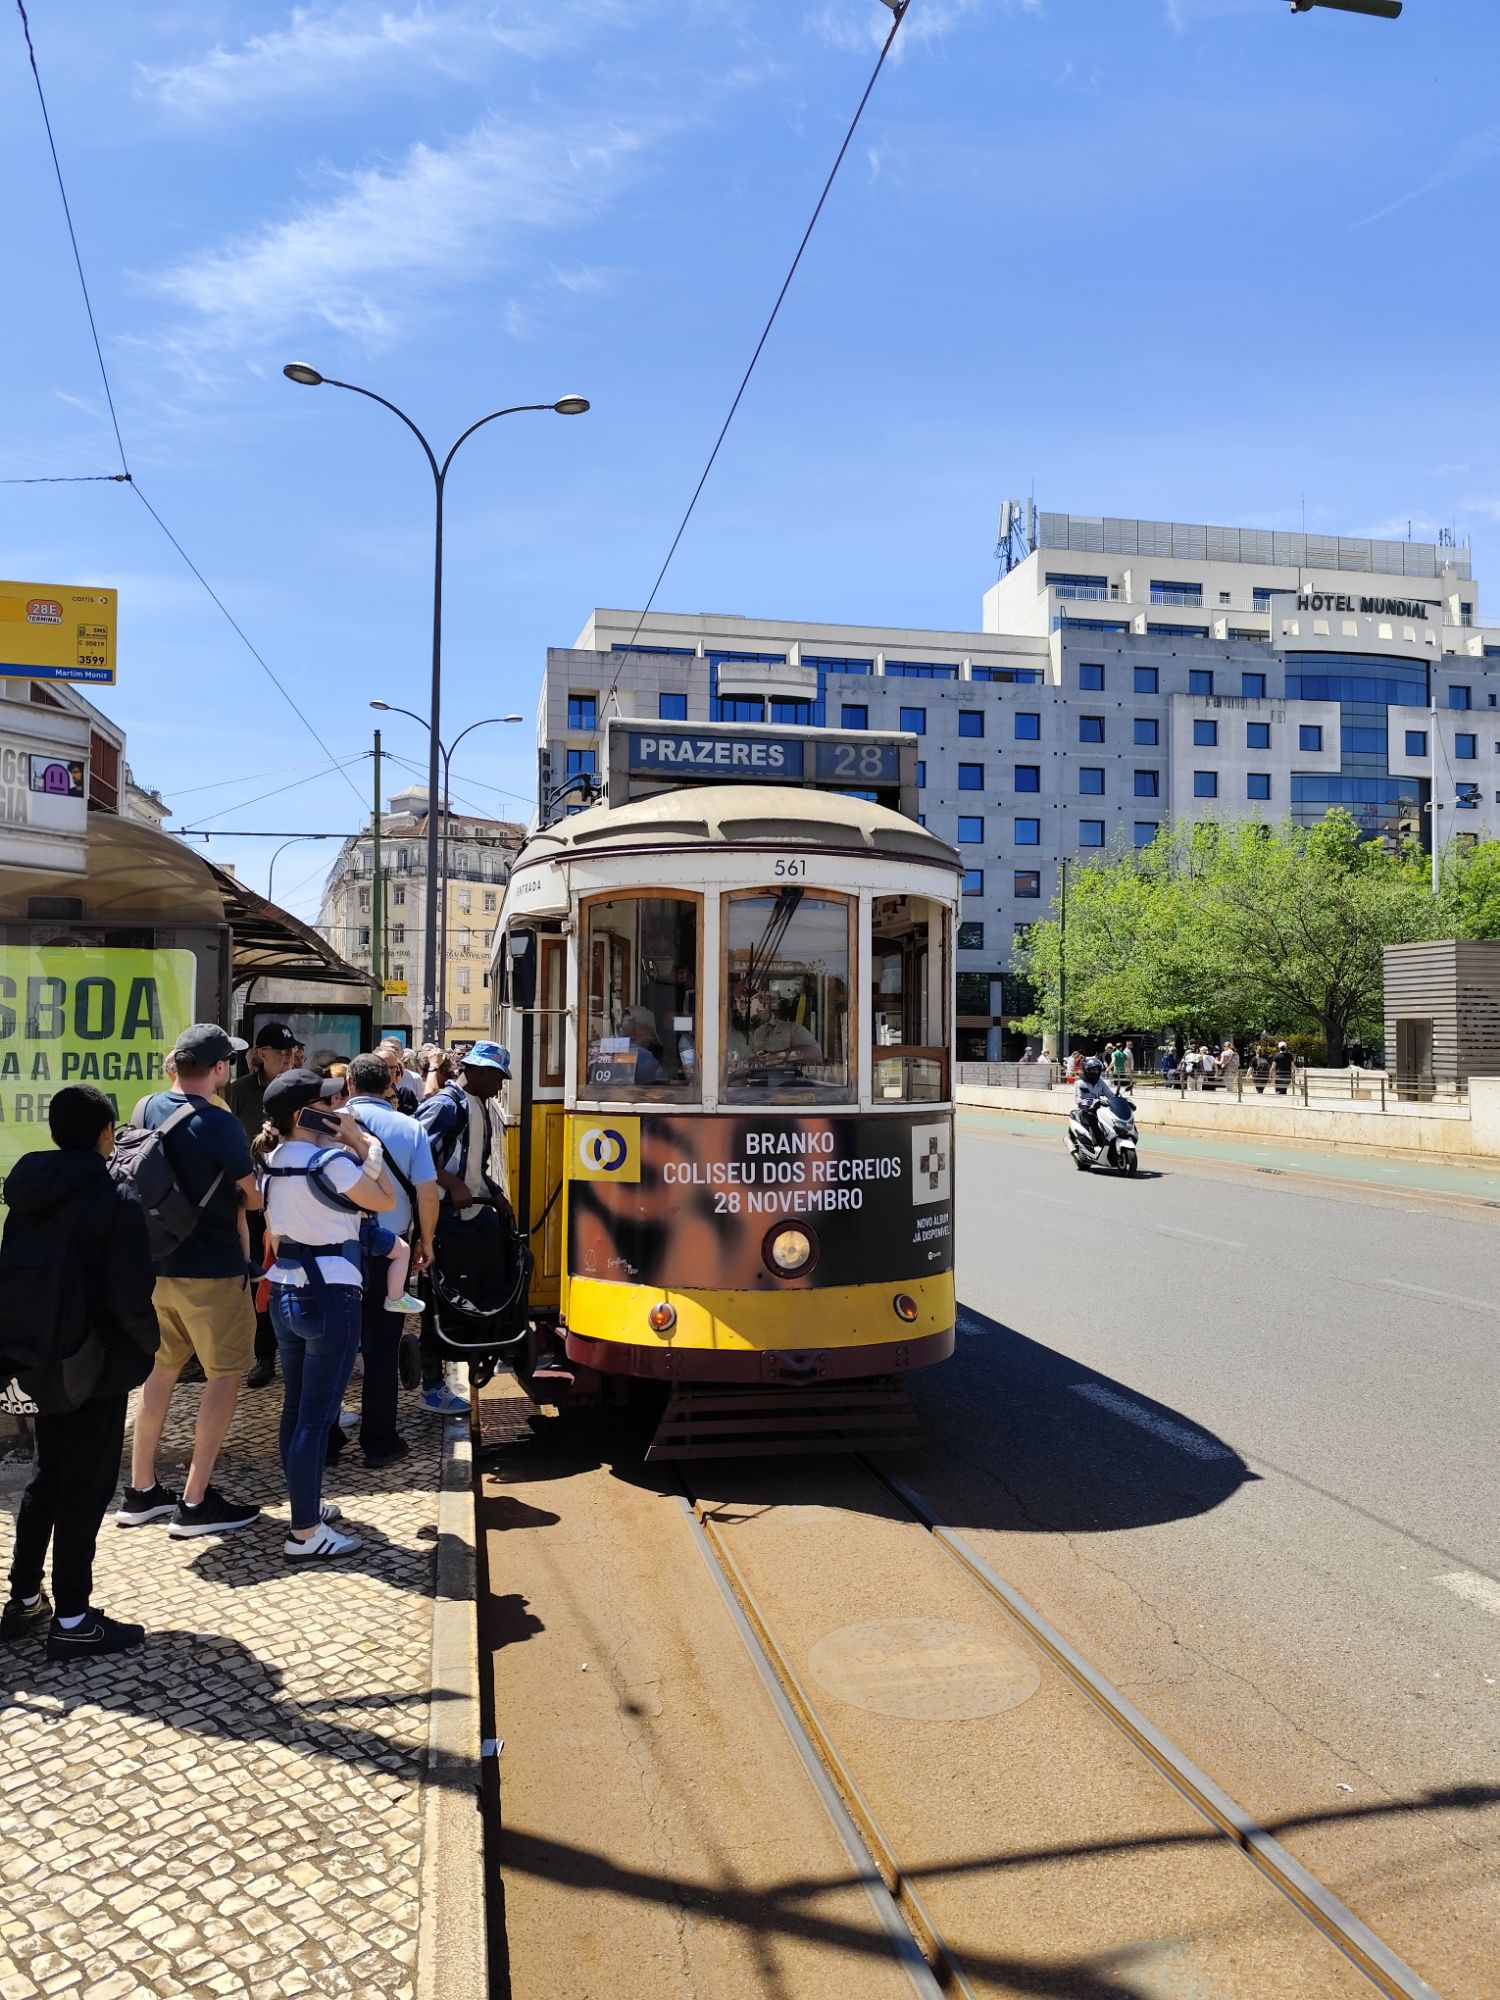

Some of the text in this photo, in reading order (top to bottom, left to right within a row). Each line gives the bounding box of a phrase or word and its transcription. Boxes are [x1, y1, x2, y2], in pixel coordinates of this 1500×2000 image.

[32, 603, 57, 615] 28E
[1297, 594, 1429, 620] HOTEL MUNDIAL
[28, 615, 61, 624] TERMINAL
[79, 655, 105, 665] 3599
[55, 669, 108, 679] Martim Moniz
[640, 738, 883, 778] PRAZERES 28
[774, 859, 807, 877] 561
[30, 1052, 50, 1081] A
[61, 1052, 165, 1081] PAGAR
[595, 1070, 611, 1082] 09
[745, 1131, 834, 1155] BRANKO
[663, 1156, 902, 1184] COLISEU DOS RECREIOS
[714, 1187, 863, 1214] 28 NOVEMBRO
[917, 1217, 933, 1229] NOVO
